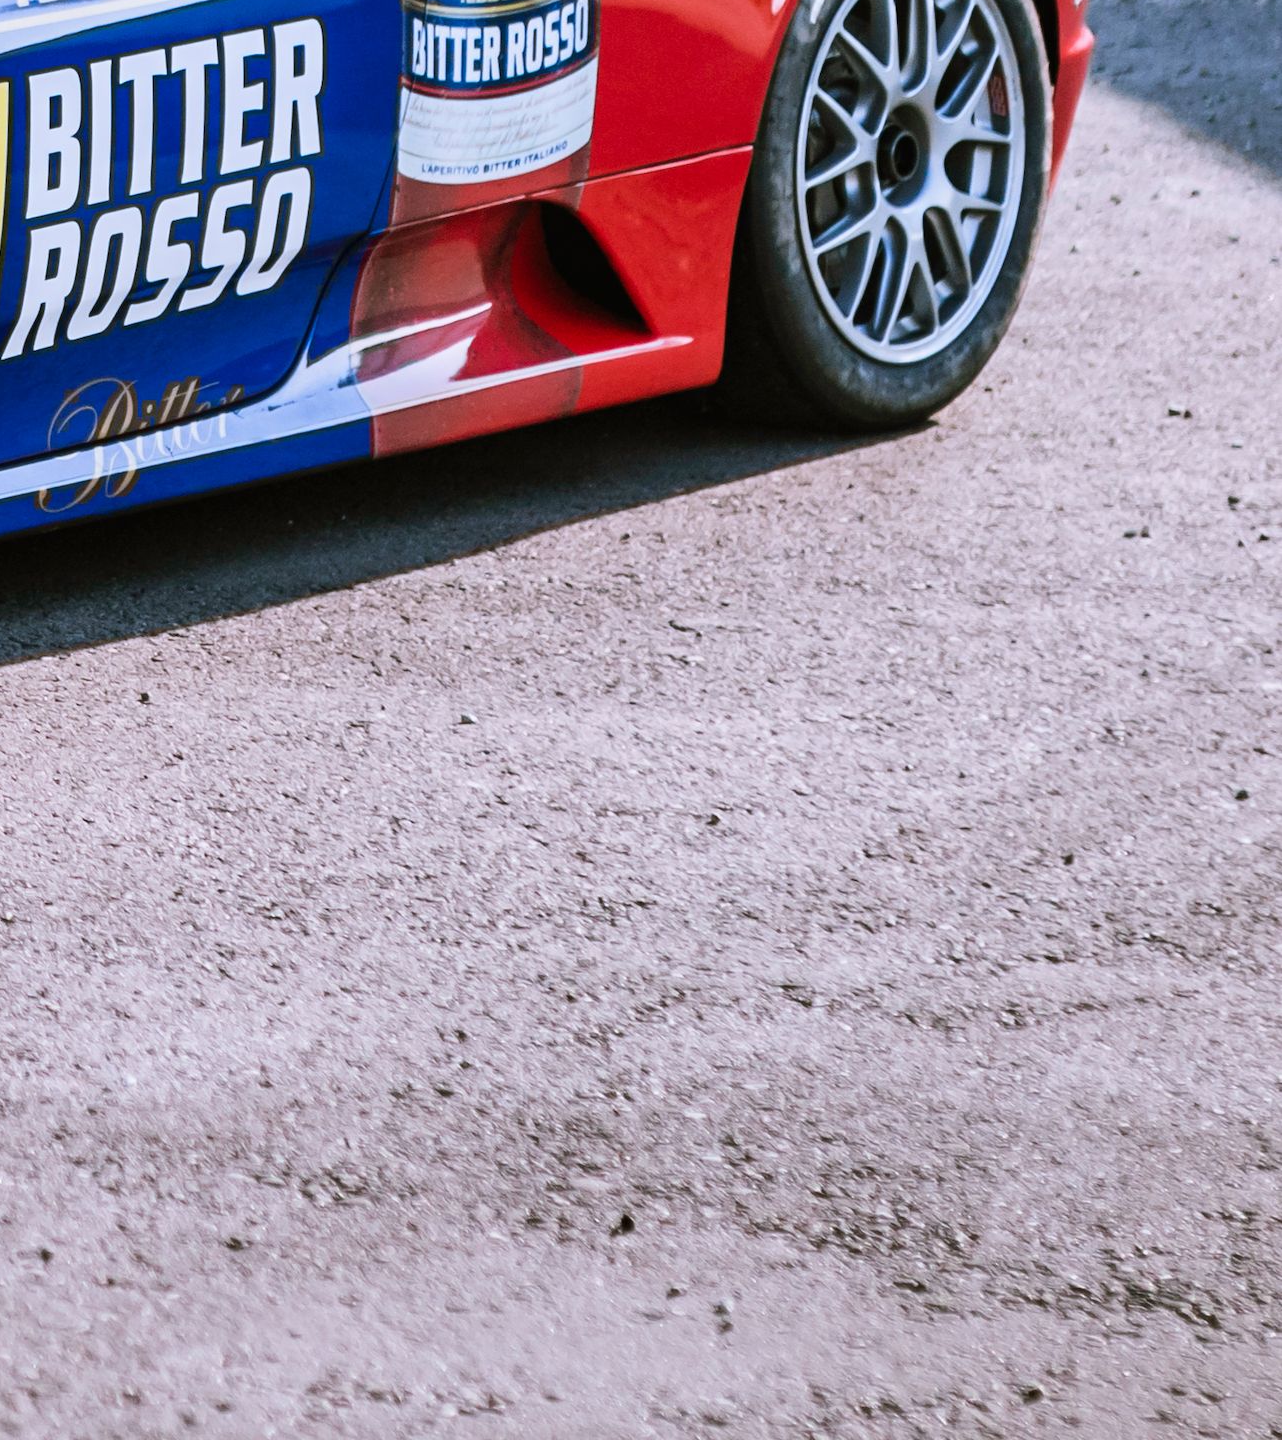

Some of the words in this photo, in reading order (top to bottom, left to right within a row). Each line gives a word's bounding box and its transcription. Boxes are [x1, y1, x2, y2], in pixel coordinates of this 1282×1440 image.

[412, 17, 501, 84] BITTER
[25, 17, 325, 220] BITTER
[421, 162, 480, 176] L'APERITIVO
[483, 157, 522, 173] BITTER
[524, 140, 568, 167] ITALIANO
[0, 167, 313, 361] ROSSO
